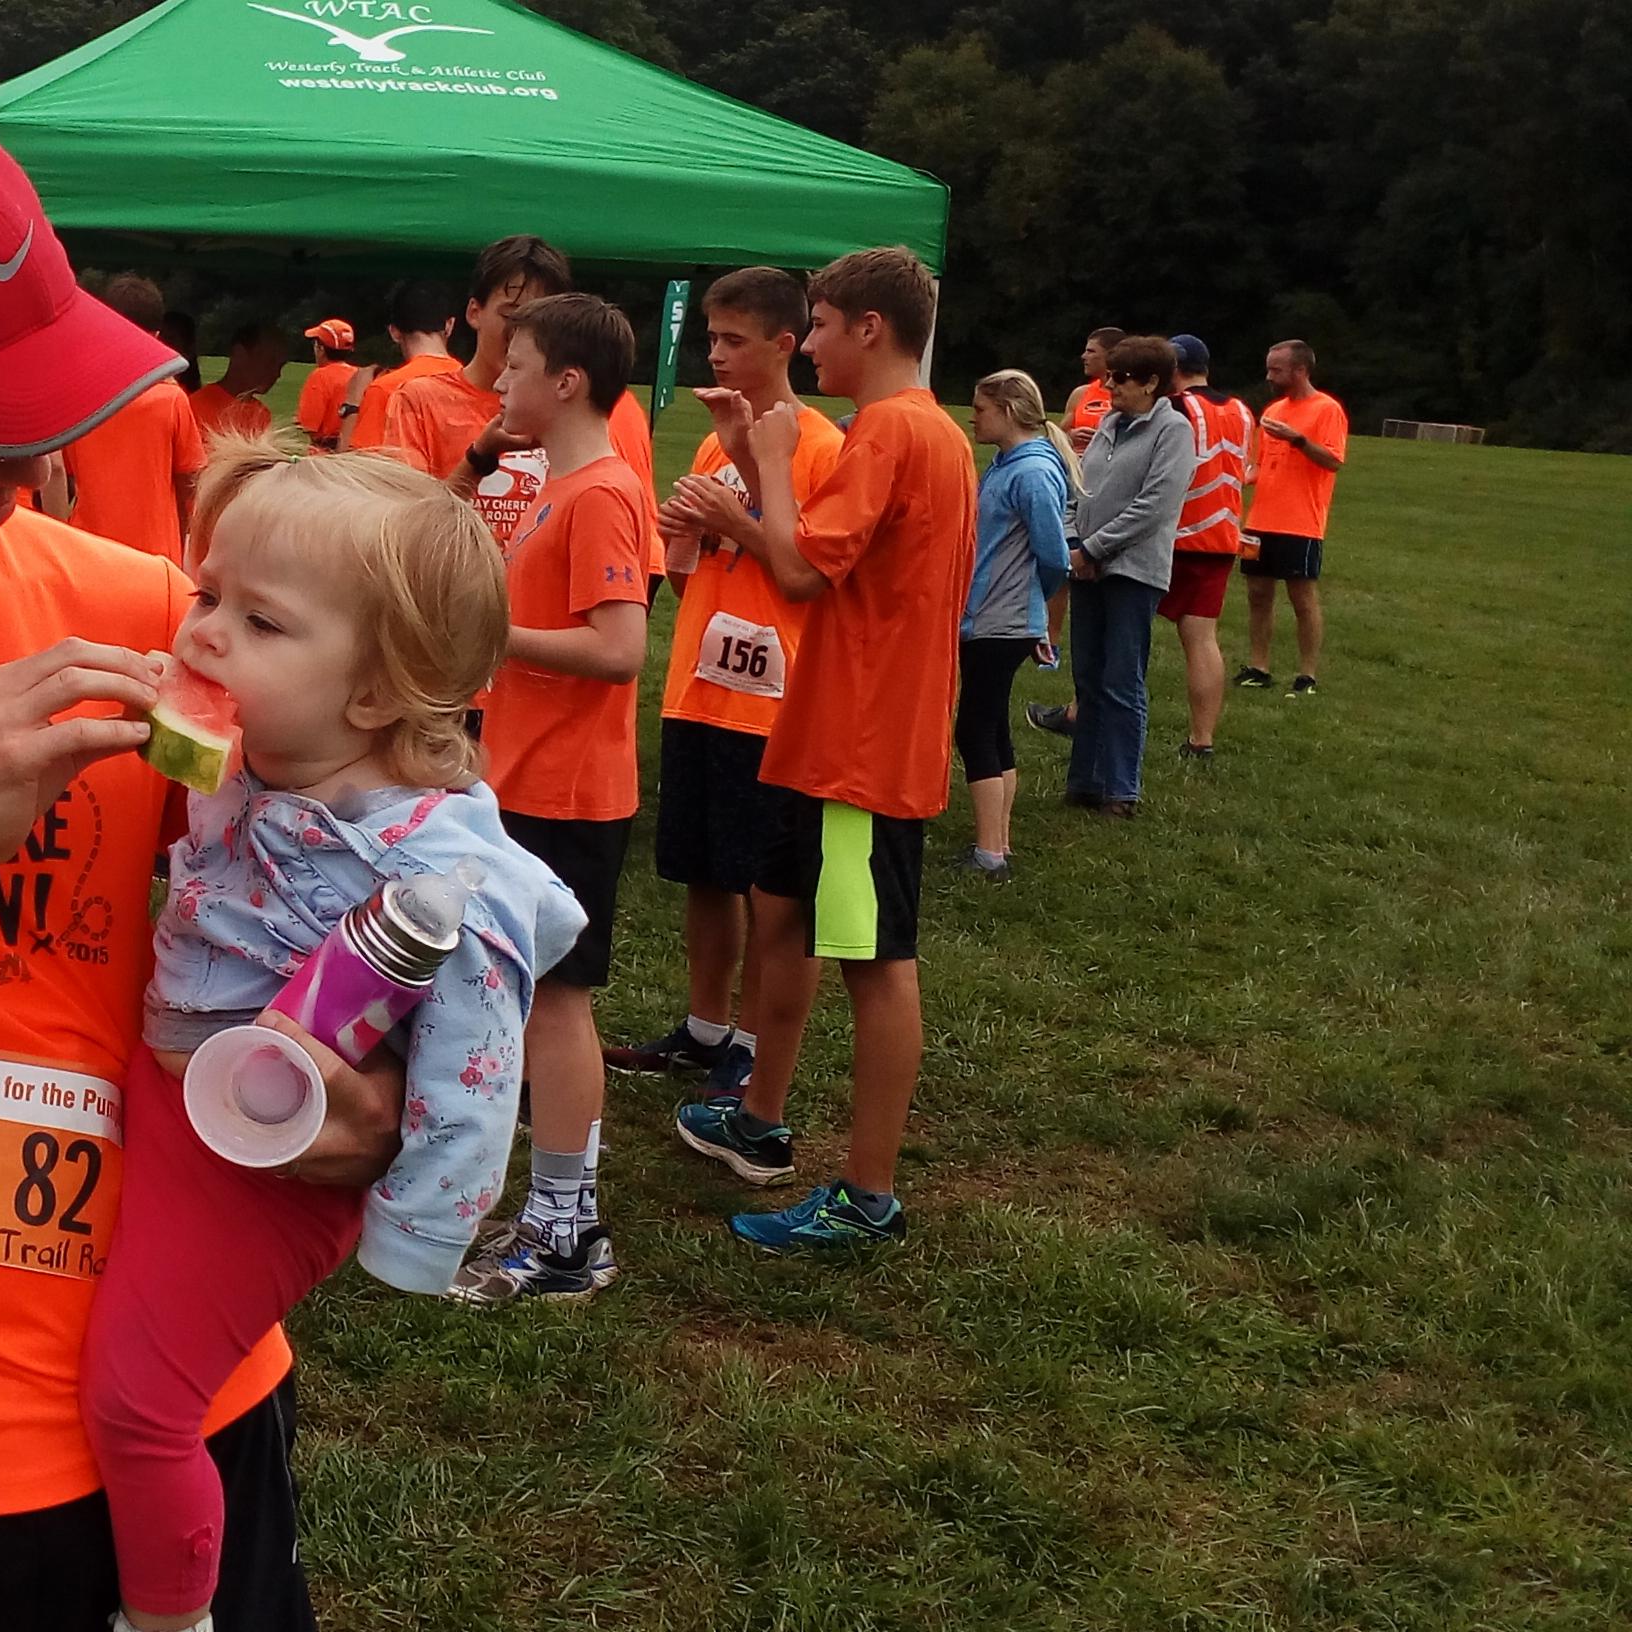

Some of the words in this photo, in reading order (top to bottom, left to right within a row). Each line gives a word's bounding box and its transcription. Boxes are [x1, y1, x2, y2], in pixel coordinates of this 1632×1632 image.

[304, 0, 433, 23] WTAC
[264, 61, 346, 75] Westerly
[350, 62, 409, 76] Track
[411, 66, 426, 75] &
[428, 66, 501, 79] Athletic
[506, 70, 546, 81] Club
[278, 78, 558, 100] westerlytrackclub.org
[486, 510, 517, 521] ROAD
[717, 635, 769, 678] 156
[67, 941, 109, 965] 2015
[4, 1075, 36, 1101] for
[42, 1081, 76, 1109] the
[14, 1131, 103, 1236] 82
